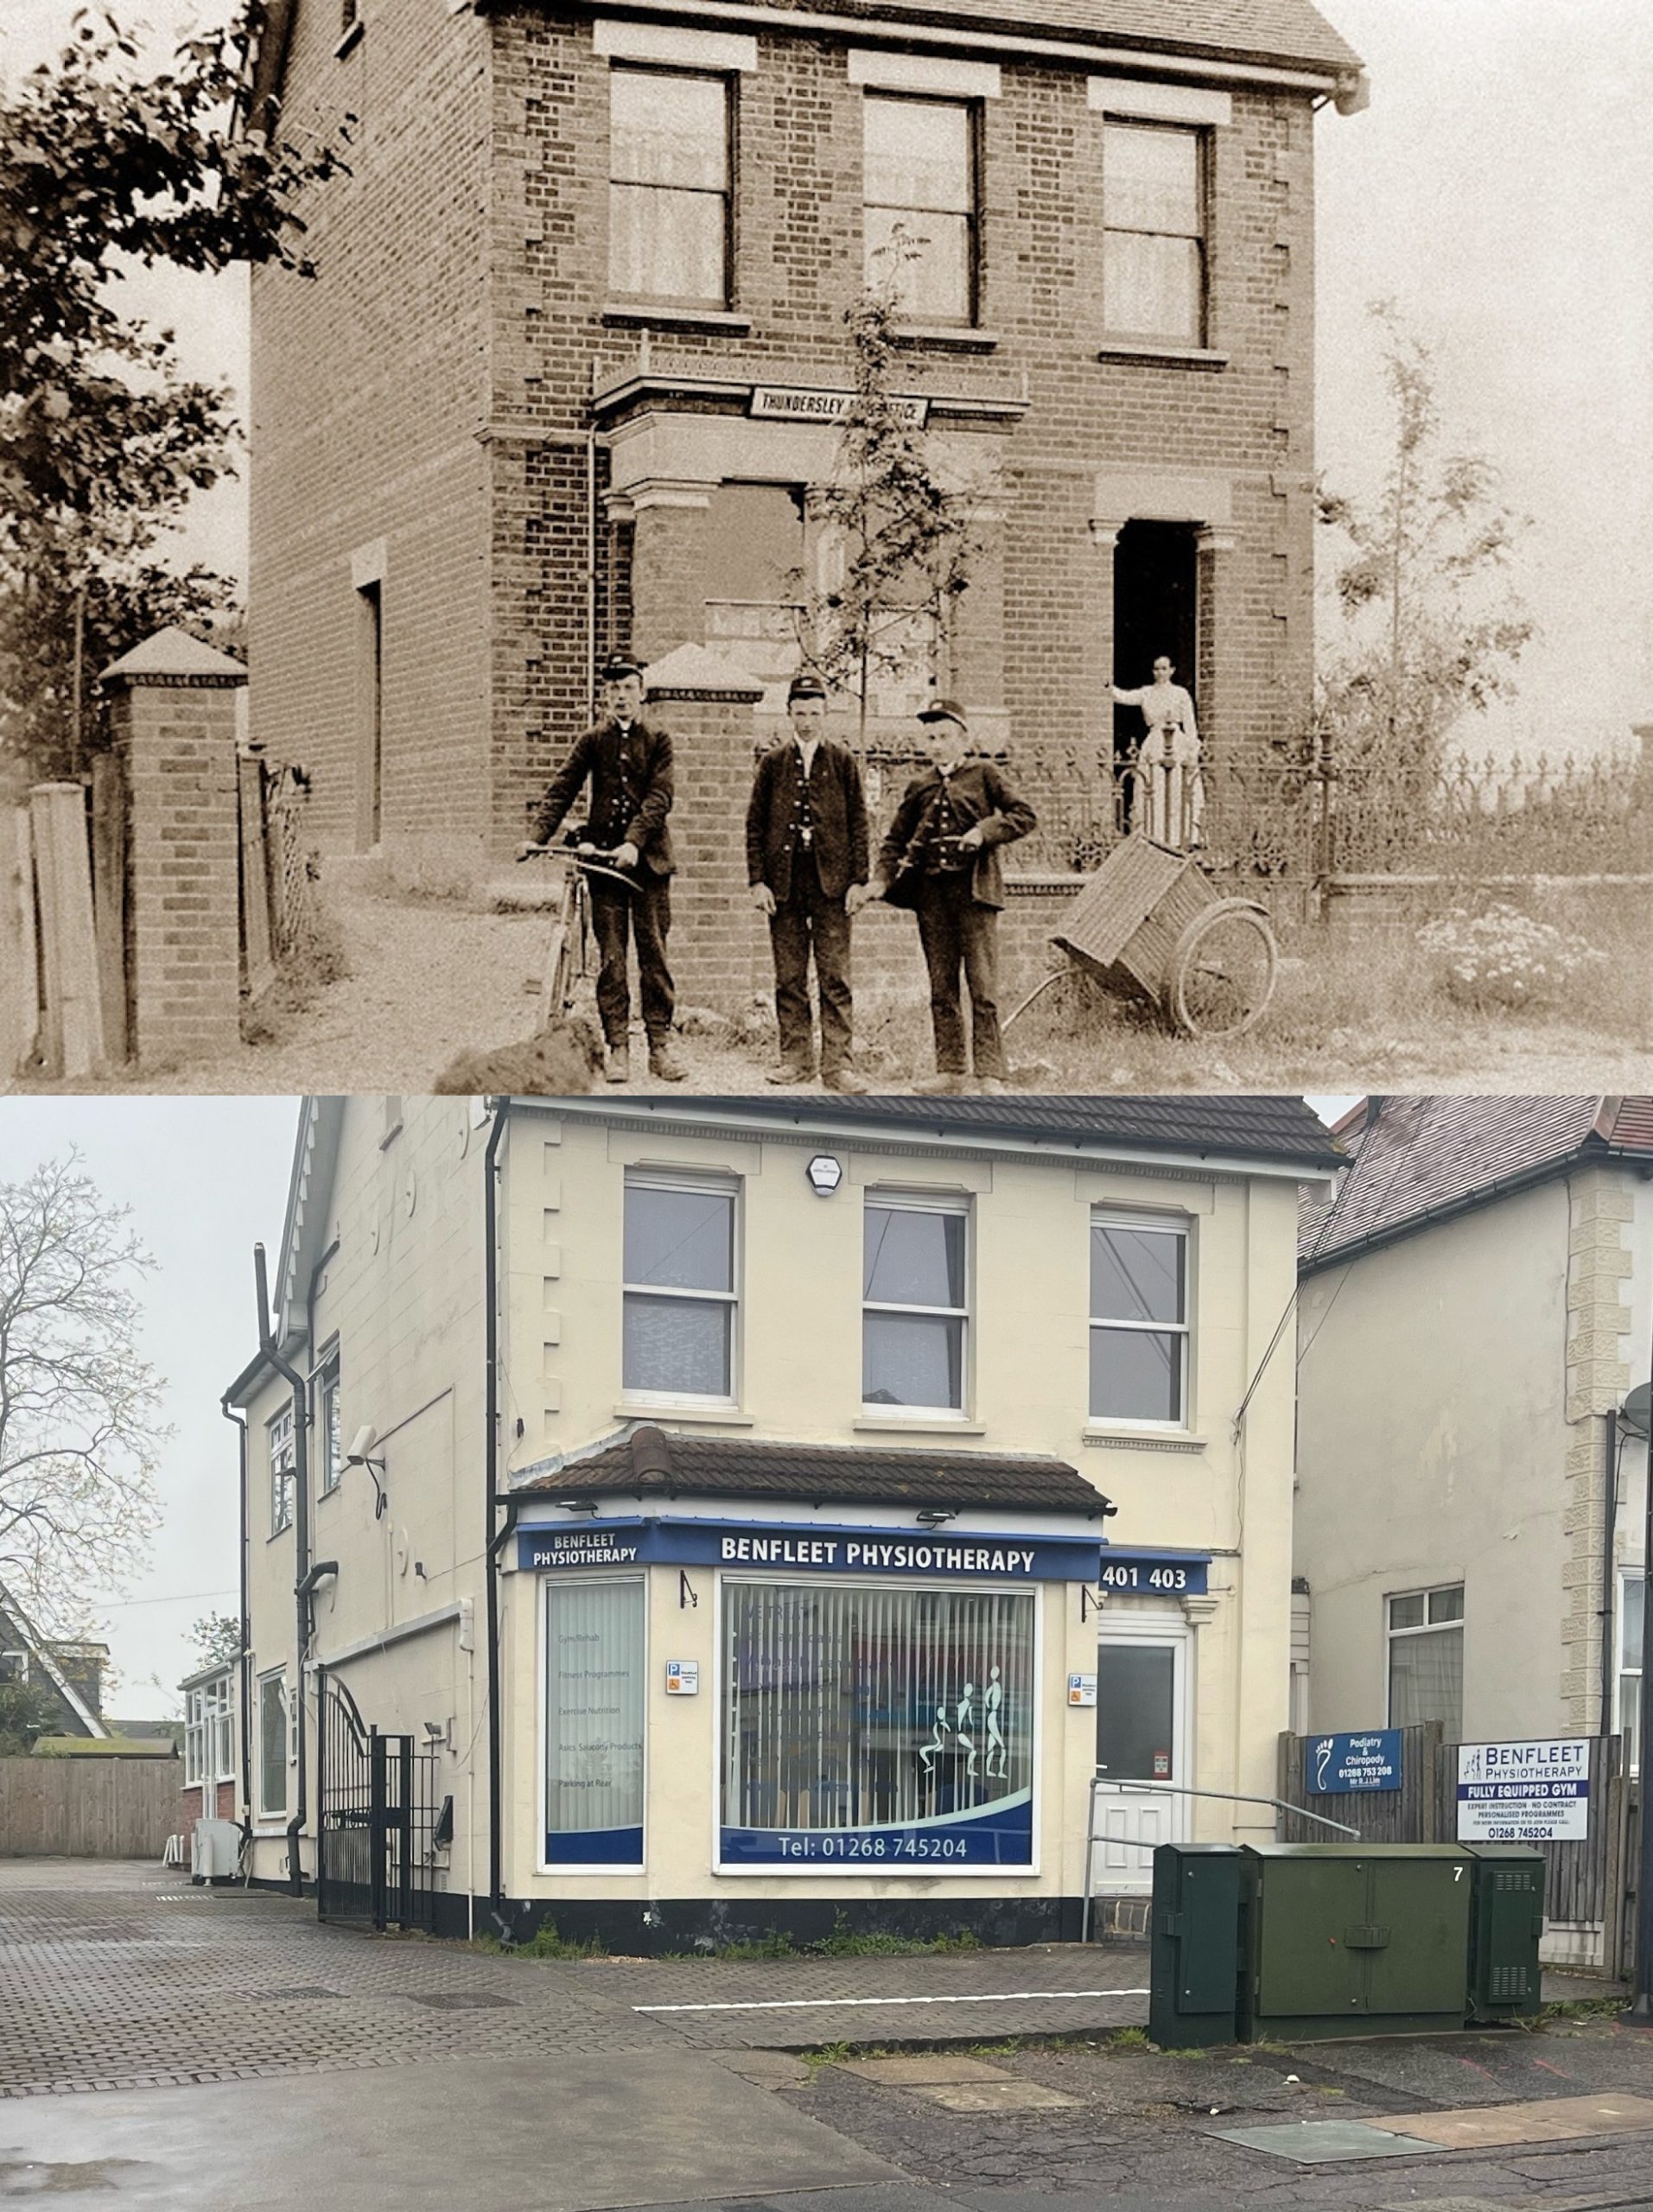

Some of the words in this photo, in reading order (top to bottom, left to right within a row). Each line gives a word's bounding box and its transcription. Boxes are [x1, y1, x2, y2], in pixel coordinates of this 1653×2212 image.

[762, 392, 844, 415] THUNDERSLEY
[554, 1533, 616, 1549] BENFLEET
[533, 1548, 637, 1566] PHYSIOTHERAPY
[722, 1537, 837, 1564] BENFLEET
[847, 1542, 1035, 1573] PHYSIOTHERAPY
[1102, 1566, 1138, 1586] 401
[1149, 1568, 1186, 1589] 403
[584, 1670, 630, 1680] Programmes
[609, 1742, 642, 1751] Products
[1350, 1737, 1382, 1748] Podiatry
[1362, 1747, 1369, 1756] &
[1485, 1745, 1583, 1765] BENFLEET
[1345, 1753, 1385, 1766] Chiropody
[1363, 1766, 1376, 1777] 753
[1485, 1766, 1582, 1780] PHYSIOTHERAPY
[558, 1780, 586, 1789] Parking
[595, 1778, 612, 1787] Rear
[1468, 1785, 1496, 1798] FULLY
[1497, 1783, 1548, 1797] EQUIPPED
[1551, 1783, 1577, 1796] GYM
[1488, 1827, 1515, 1838] 01268
[1518, 1827, 1553, 1838] 745204
[778, 1837, 816, 1856] Tel:
[822, 1838, 886, 1857] 01268
[893, 1839, 967, 1857] 745204
[1453, 1866, 1464, 1881] 7
